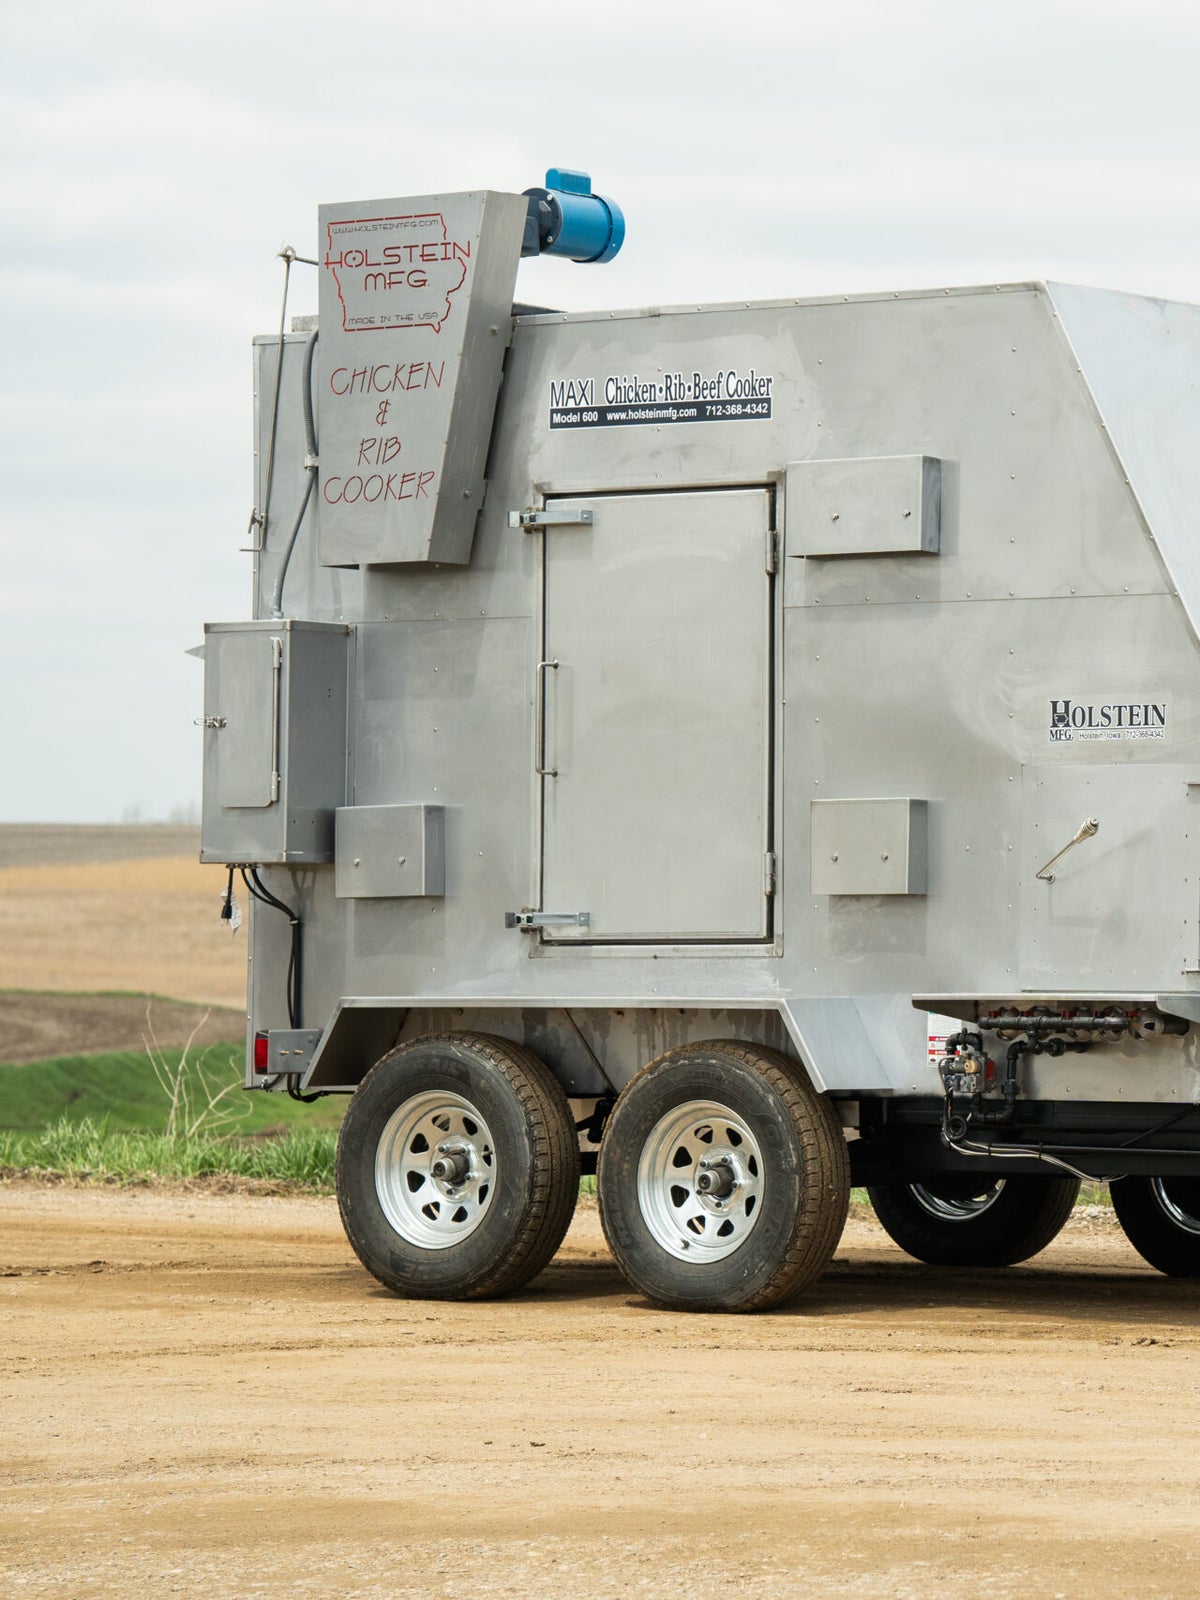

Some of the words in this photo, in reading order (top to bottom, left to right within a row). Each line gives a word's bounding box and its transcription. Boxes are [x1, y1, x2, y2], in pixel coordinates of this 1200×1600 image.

[325, 241, 470, 269] HOLSTEIN
[348, 316, 375, 325] MADE
[380, 315, 391, 323] IN
[395, 313, 414, 321] THE
[417, 311, 439, 320] USA
[330, 361, 445, 395] CHICKEN
[550, 379, 594, 407] MAXI
[726, 369, 772, 399] Cooker
[375, 399, 391, 426] &
[552, 412, 580, 423] Model
[582, 411, 599, 422] 600
[606, 406, 697, 420] www.holsteinmfg.com
[705, 402, 769, 416] 712-368-4342
[358, 436, 401, 466] RIB
[323, 471, 435, 504] COOKER
[1049, 699, 1166, 728] HOLSTEIN
[1049, 729, 1074, 741] MFG.
